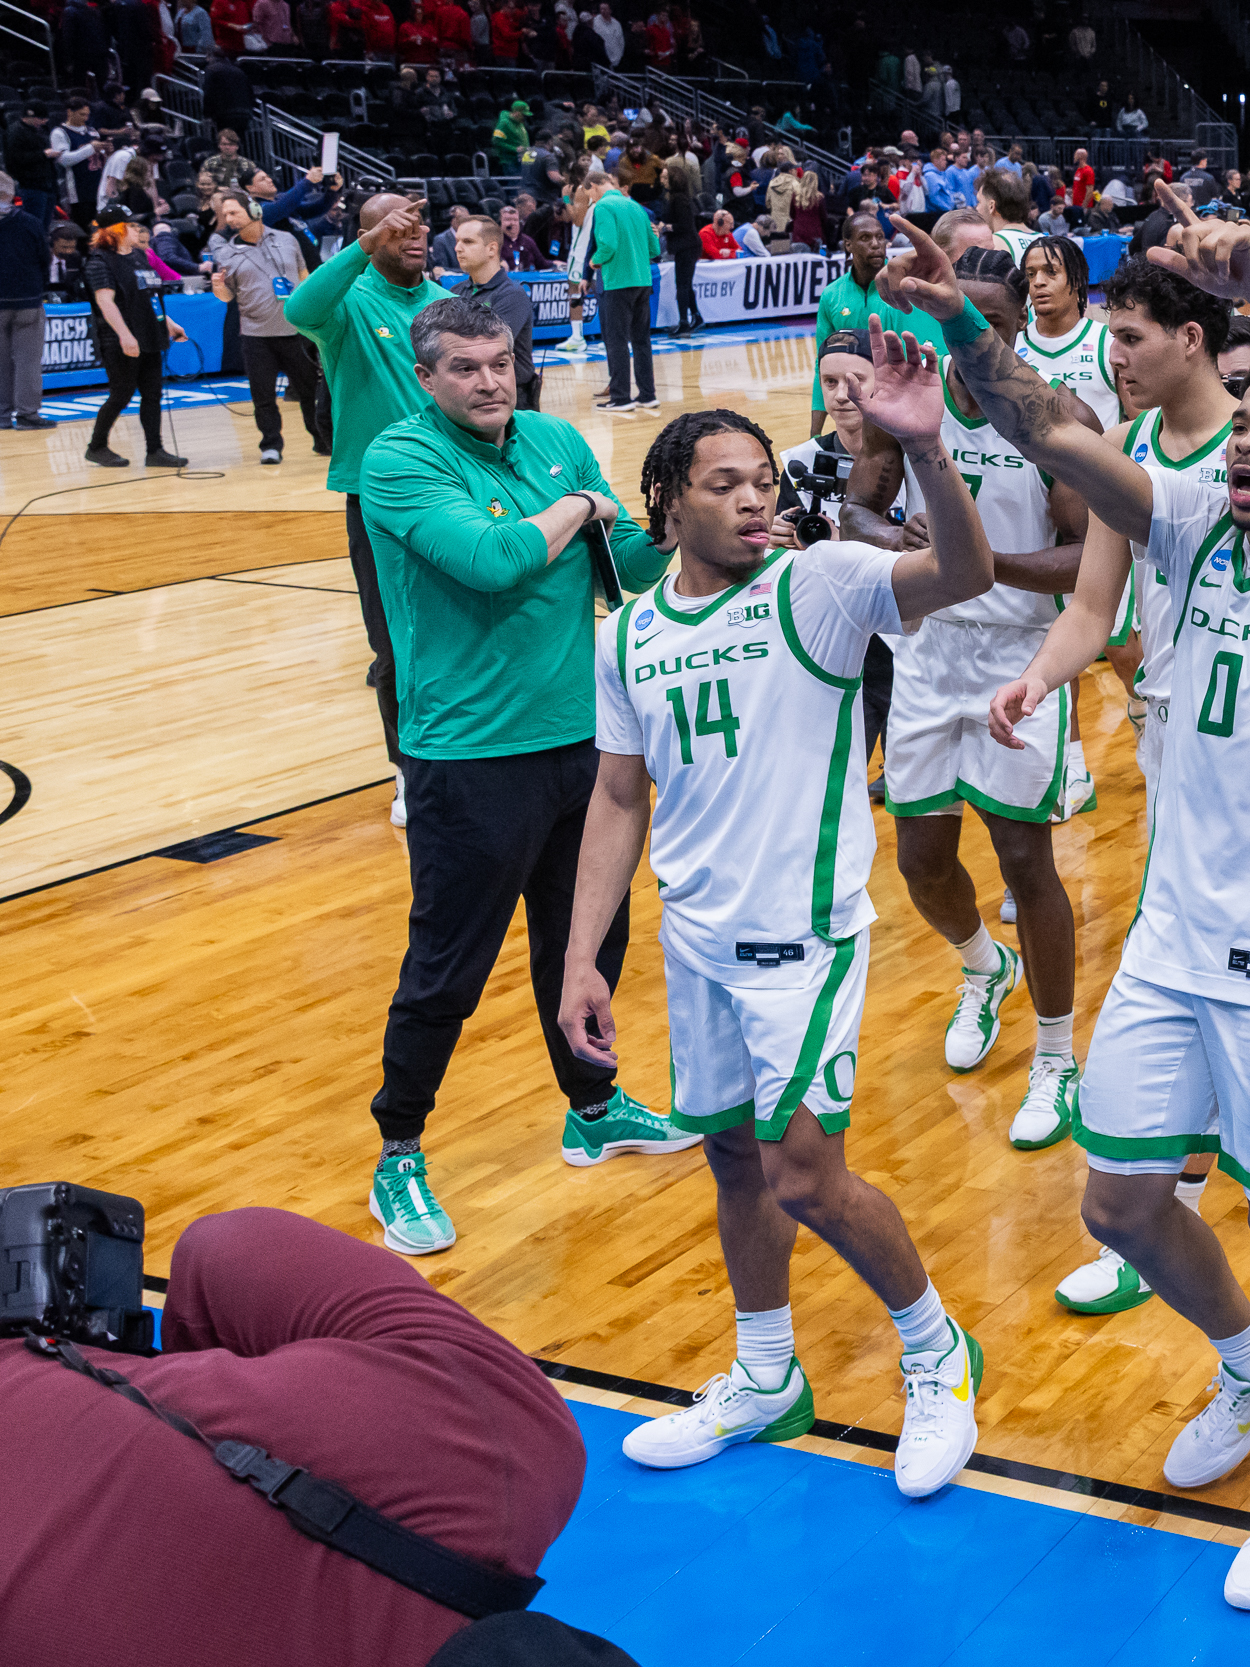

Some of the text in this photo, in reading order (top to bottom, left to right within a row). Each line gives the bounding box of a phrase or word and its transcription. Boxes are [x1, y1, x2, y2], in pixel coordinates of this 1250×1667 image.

[532, 283, 569, 302] MARC
[720, 281, 736, 297] BY
[41, 339, 95, 365] MADNE
[635, 641, 769, 684] DUCKS
[666, 678, 740, 765] 14
